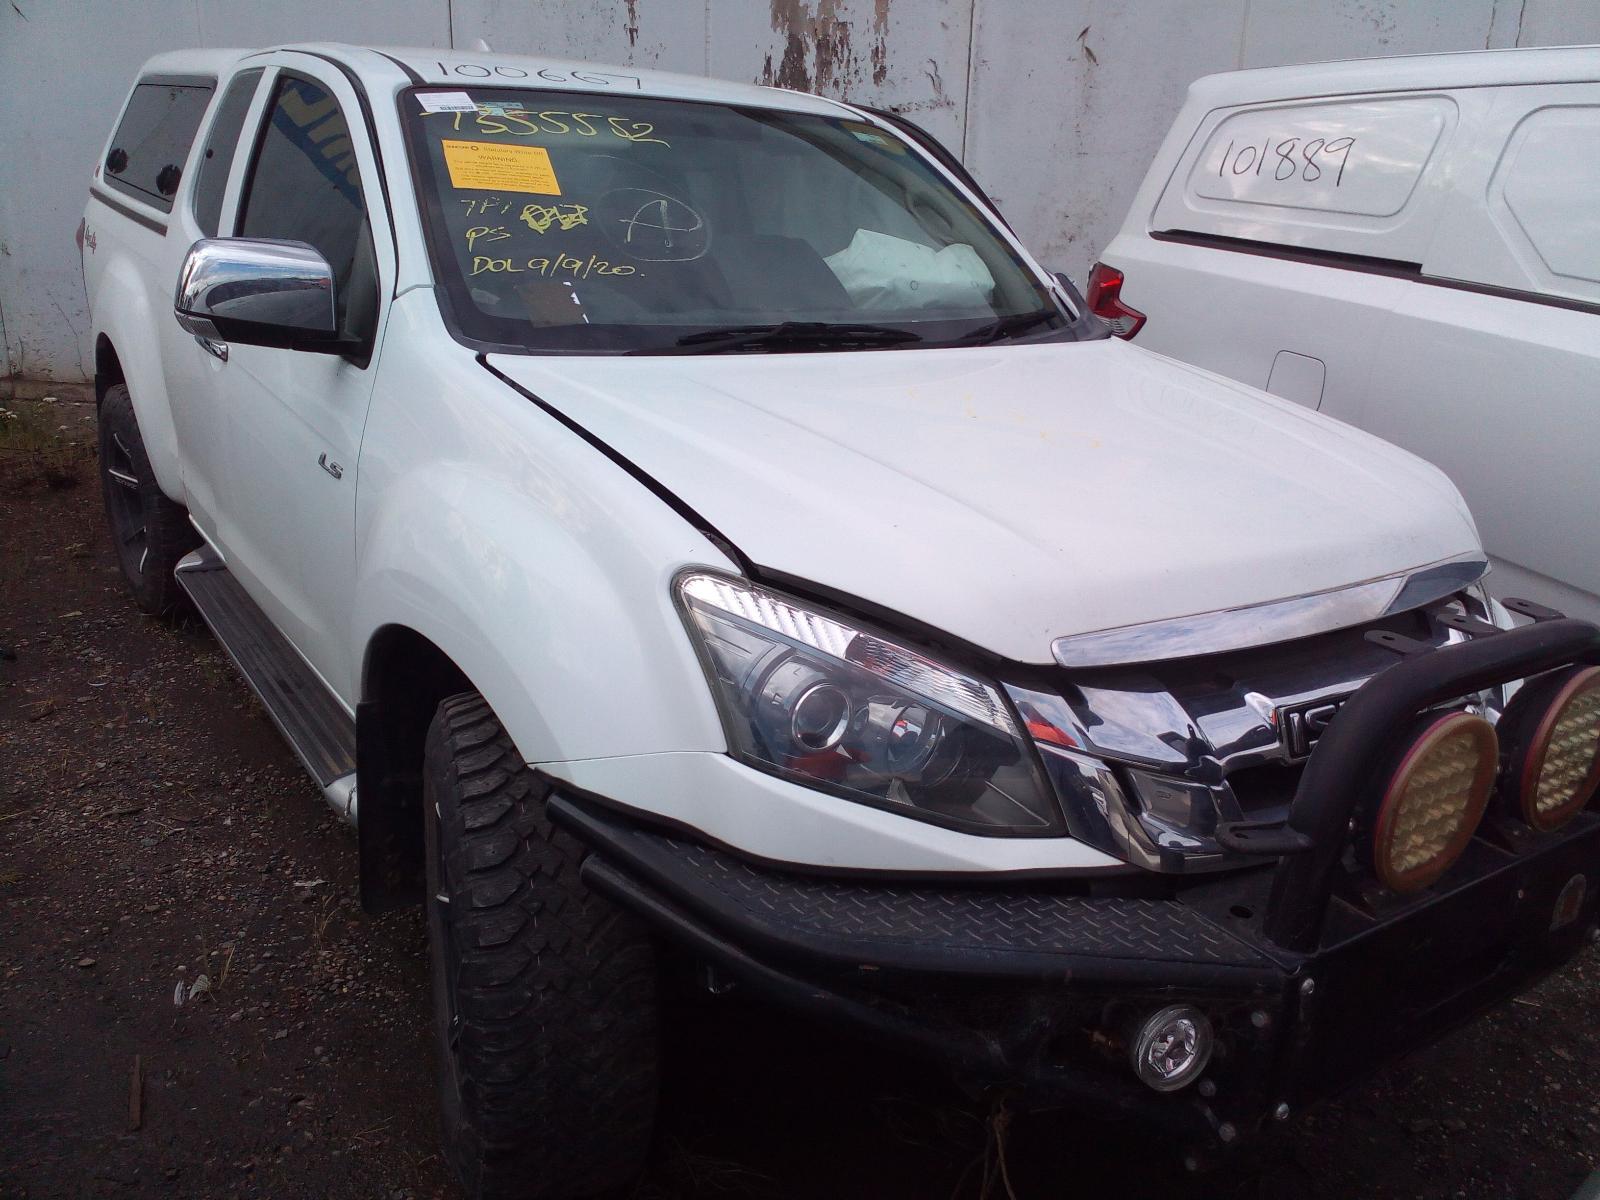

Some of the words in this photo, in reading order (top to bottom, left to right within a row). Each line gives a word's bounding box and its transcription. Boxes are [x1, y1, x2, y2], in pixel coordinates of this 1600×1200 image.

[437, 61, 641, 90] 100667
[1219, 136, 1357, 188] 101889
[468, 256, 525, 276] DOL
[317, 452, 344, 480] LS
